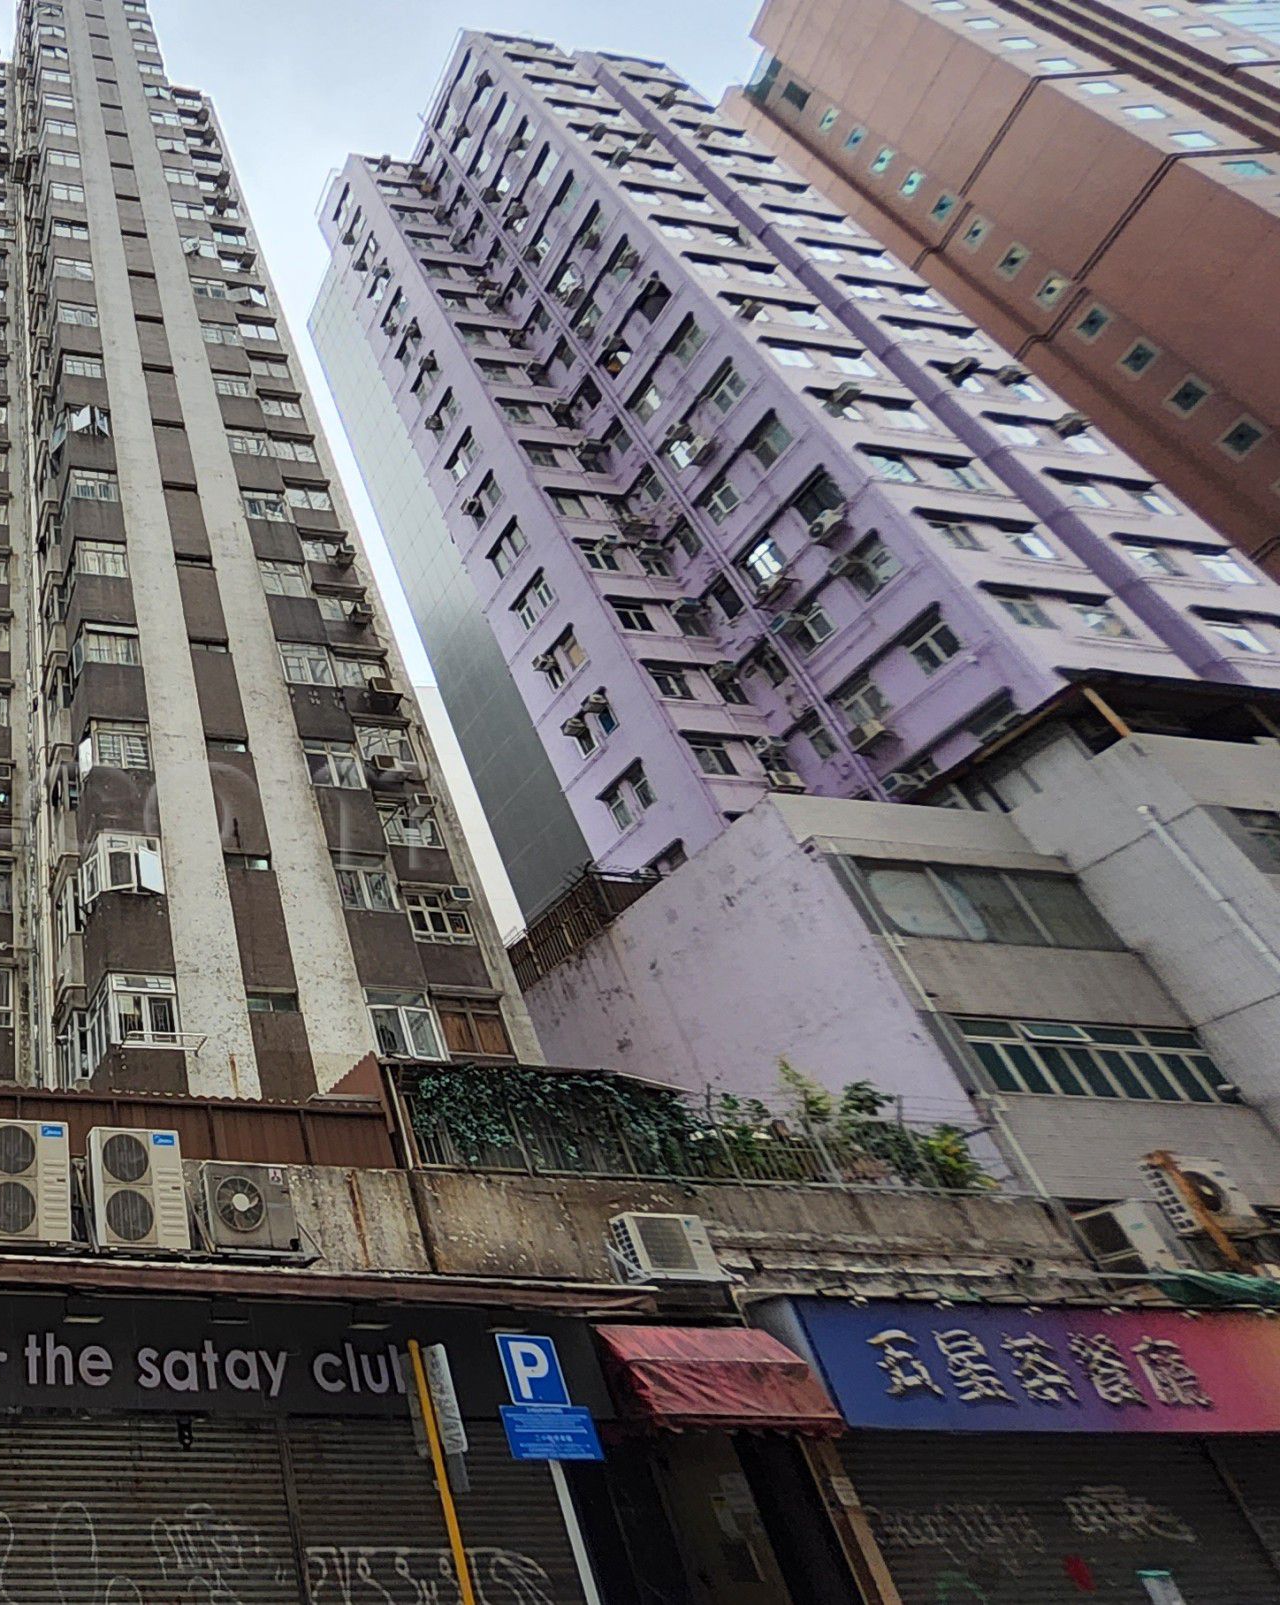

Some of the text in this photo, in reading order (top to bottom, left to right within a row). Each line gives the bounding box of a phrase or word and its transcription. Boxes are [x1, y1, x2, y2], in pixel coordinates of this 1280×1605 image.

[24, 1332, 114, 1386] the
[137, 1339, 288, 1397] satay
[507, 1341, 549, 1399] P
